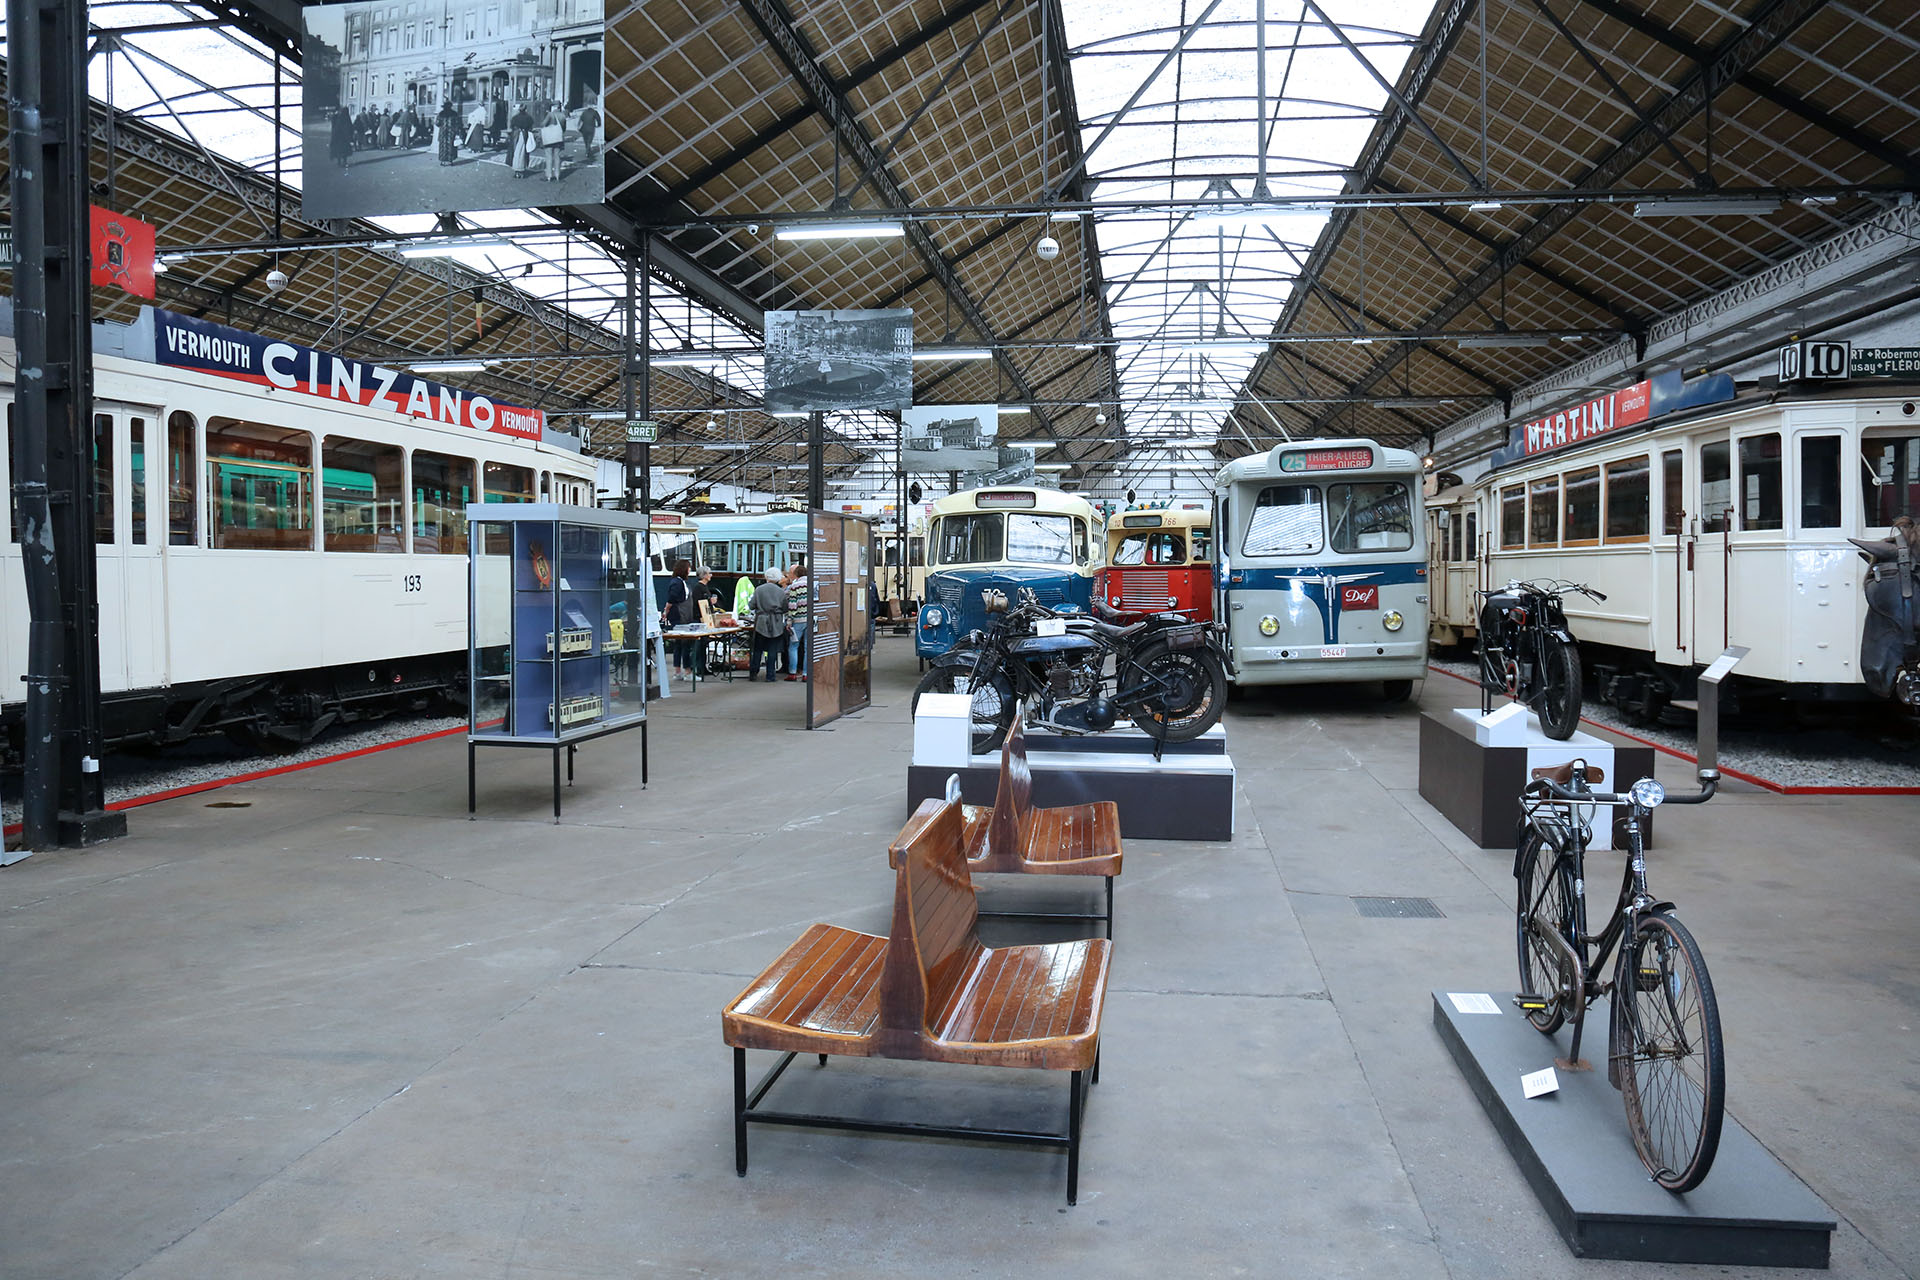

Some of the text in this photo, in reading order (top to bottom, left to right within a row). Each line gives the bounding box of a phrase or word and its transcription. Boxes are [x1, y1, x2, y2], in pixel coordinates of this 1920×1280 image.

[1781, 346, 1799, 380] 10
[1810, 344, 1845, 376] 10
[1875, 349, 1920, 359] Robermo
[1851, 363, 1876, 374] usay
[165, 325, 539, 435] VERMOUTH CINZANO VERMOUTH
[1527, 394, 1615, 453] MARTINI
[583, 427, 590, 448] 4
[1284, 453, 1305, 471] 25
[1163, 518, 1177, 527] 766
[404, 575, 422, 592] 193
[1345, 588, 1375, 603] Def
